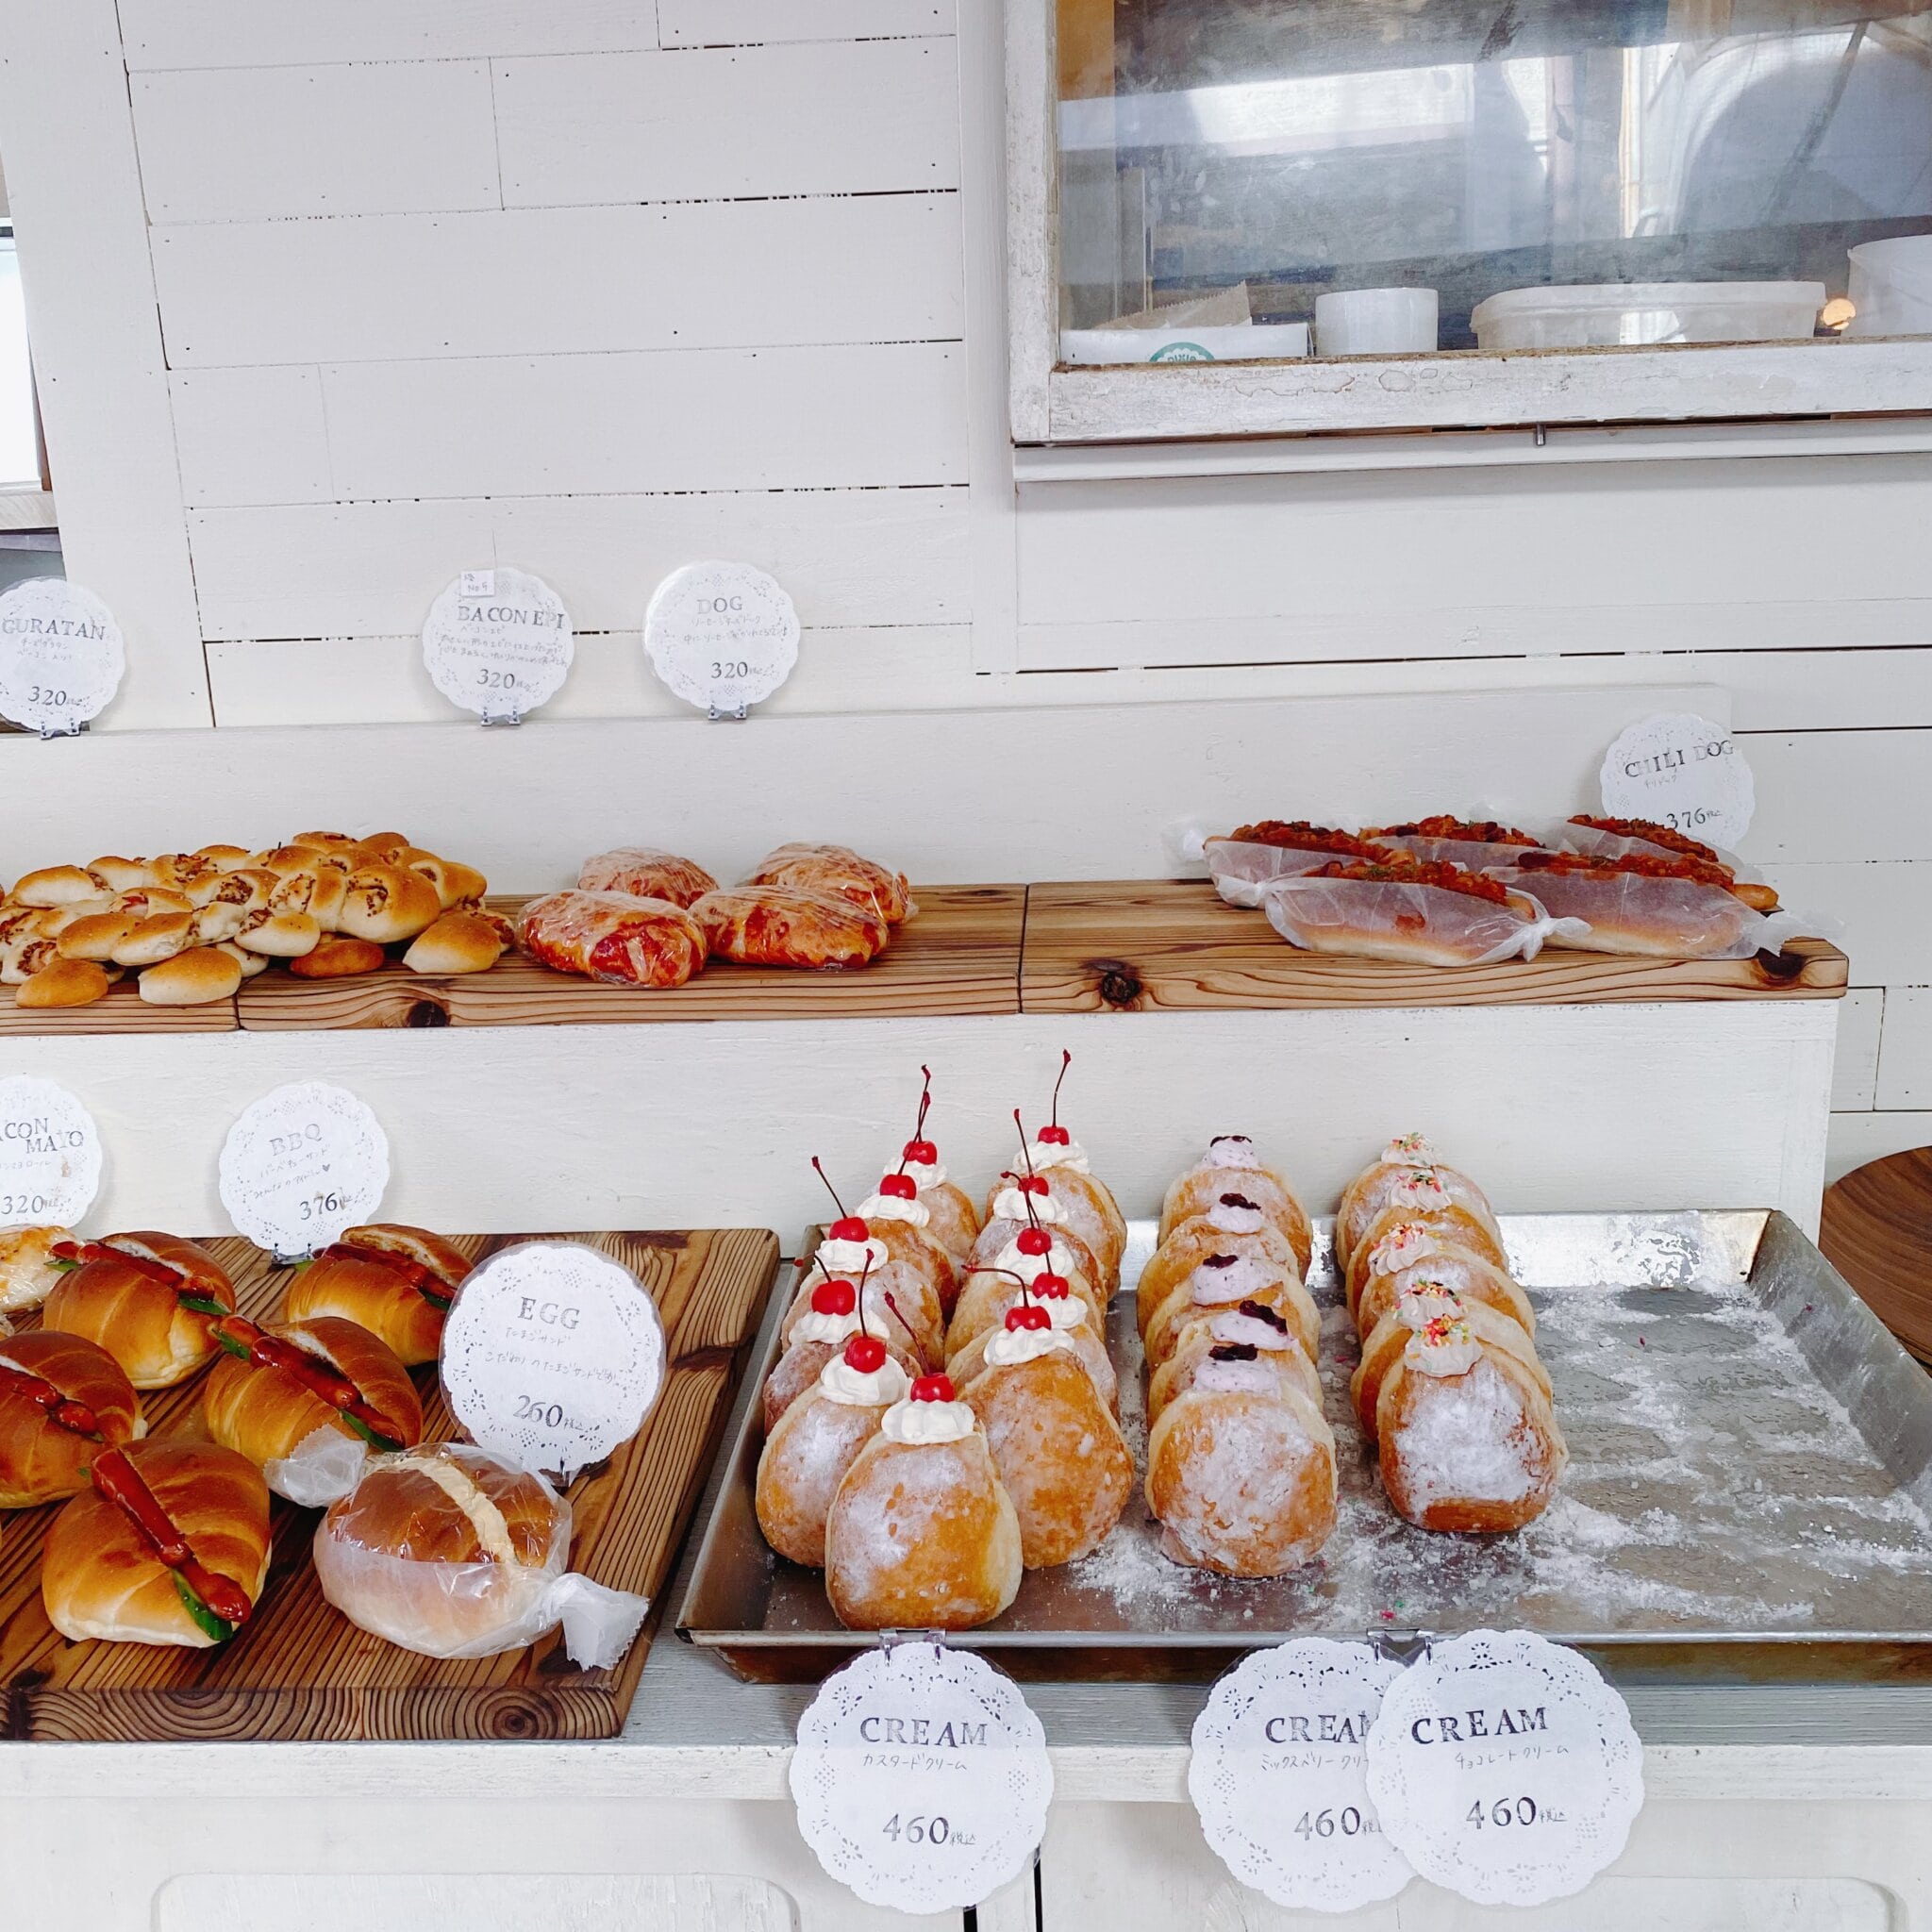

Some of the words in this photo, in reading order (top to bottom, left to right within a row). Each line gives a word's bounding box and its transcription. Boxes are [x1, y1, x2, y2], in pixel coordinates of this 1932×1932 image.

[457, 606, 527, 625] BACON
[696, 596, 742, 614] DOG
[2, 618, 106, 641] GURATAN
[476, 669, 515, 689] 320
[711, 661, 748, 678] 320
[27, 686, 67, 706] 320
[1624, 749, 1686, 777] CHILI
[1693, 740, 1733, 760] DOG
[1667, 808, 1706, 829] 376
[0, 1118, 48, 1141] CON
[269, 1124, 323, 1156] BBQ
[25, 1130, 84, 1154] MAYO
[1, 1194, 43, 1215] 320
[299, 1192, 338, 1220] 376
[518, 1296, 580, 1329] EGG
[513, 1395, 563, 1427] 260
[860, 1717, 988, 1748] CREAM
[1411, 1707, 1548, 1744] CREAM
[863, 1753, 967, 1771] カスタードクリーム
[1293, 1807, 1360, 1840] 460
[1466, 1796, 1537, 1829] 460
[882, 1813, 950, 1844] 460
